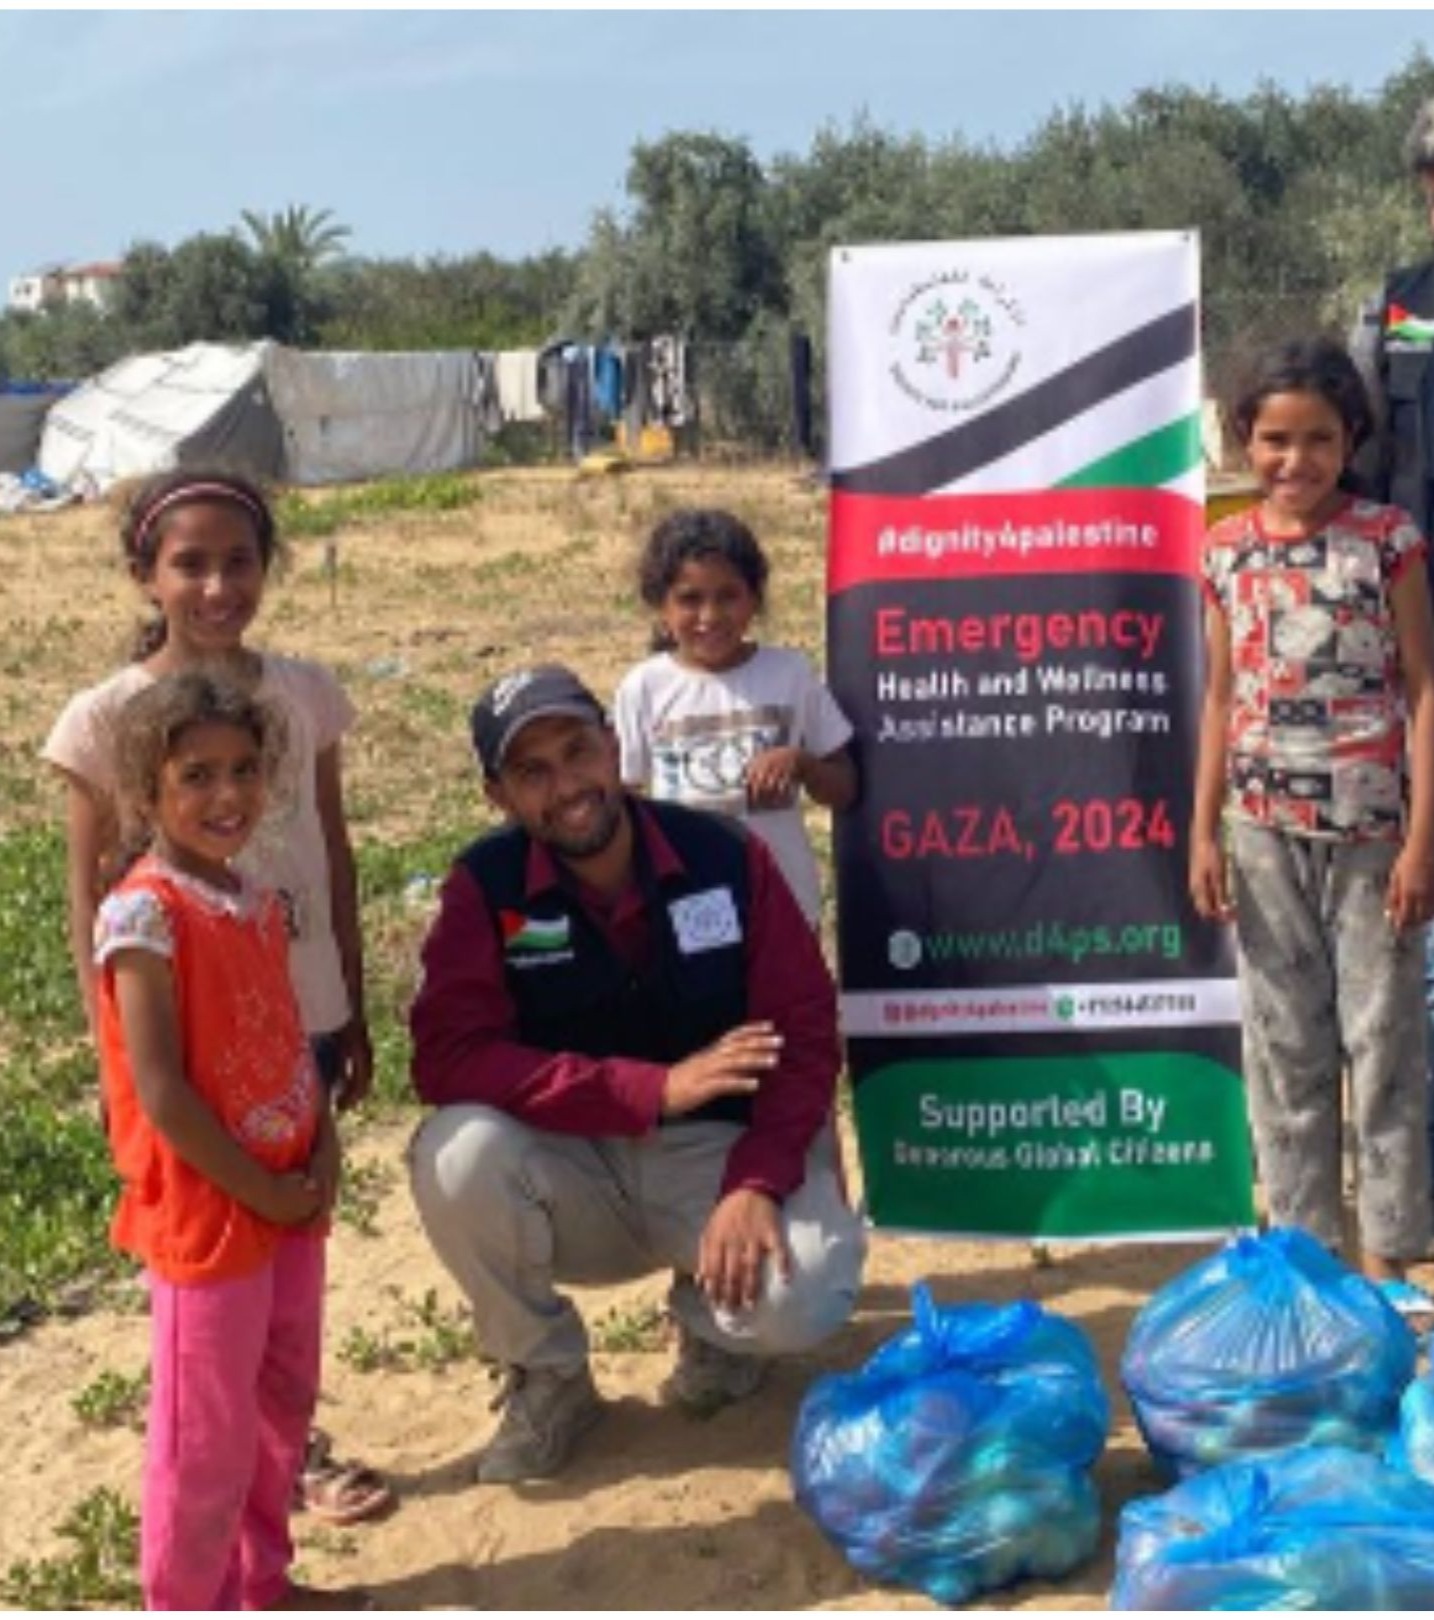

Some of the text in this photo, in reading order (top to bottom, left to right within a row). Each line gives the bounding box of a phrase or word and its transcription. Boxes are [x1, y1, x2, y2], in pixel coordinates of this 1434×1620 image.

[877, 521, 1159, 557] #dignity4palestine
[875, 608, 1164, 660] Emergency
[877, 662, 1168, 701] Health and Wellness
[877, 703, 1170, 743] Assistance Program
[882, 799, 1176, 861] GAZA, 2024
[924, 922, 1181, 963] www.d4ps.org
[919, 1088, 1166, 1138] Supported By
